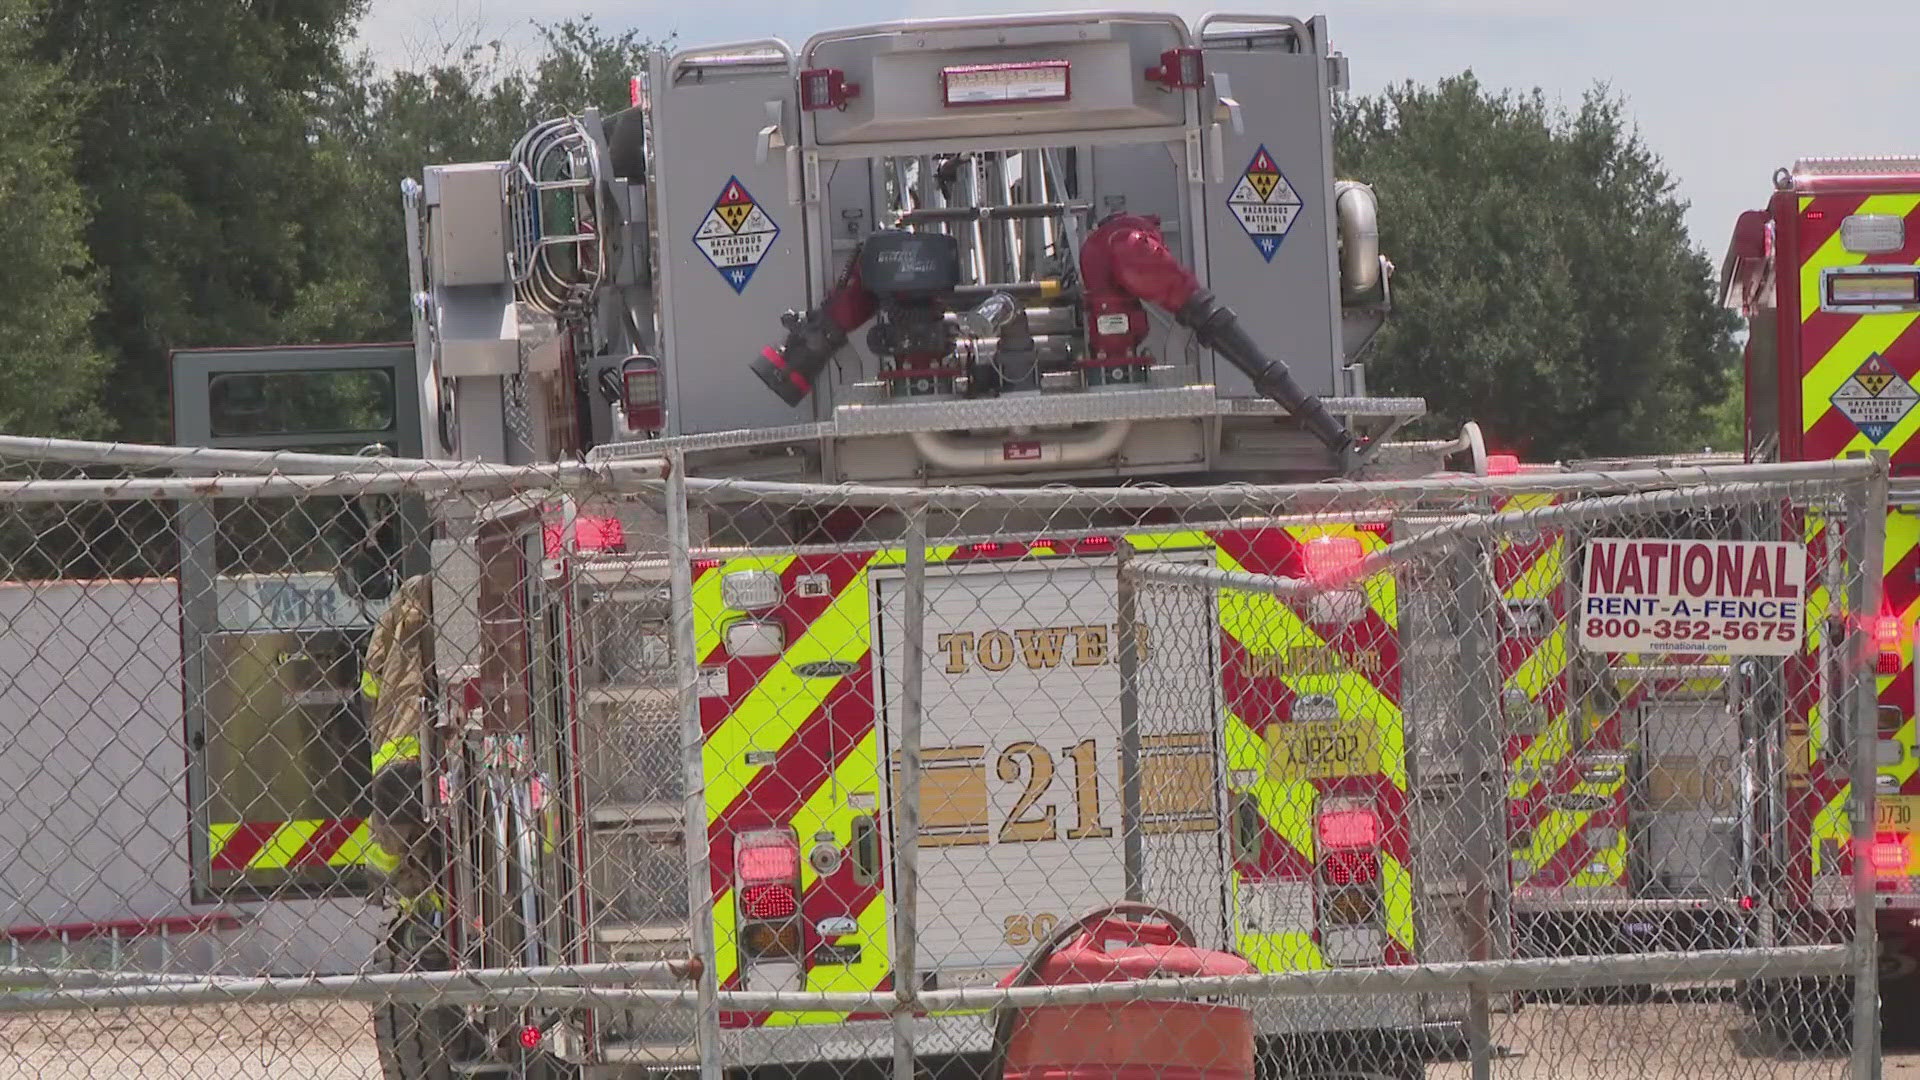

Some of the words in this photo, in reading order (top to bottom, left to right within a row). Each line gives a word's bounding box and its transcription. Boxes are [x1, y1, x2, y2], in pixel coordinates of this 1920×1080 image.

[1245, 215, 1287, 224] MATERIALS
[710, 236, 762, 247] HAZARDOUS
[713, 245, 760, 256] MATERIALS
[726, 255, 749, 264] TEAM
[1588, 542, 1799, 599] NATIONAL
[1586, 597, 1798, 619] RENT-A-FENCE
[1586, 617, 1796, 642] 800-352-5675
[937, 622, 1153, 675] TOWER
[1650, 641, 1727, 651] rentnational.com
[996, 738, 1113, 844] 21
